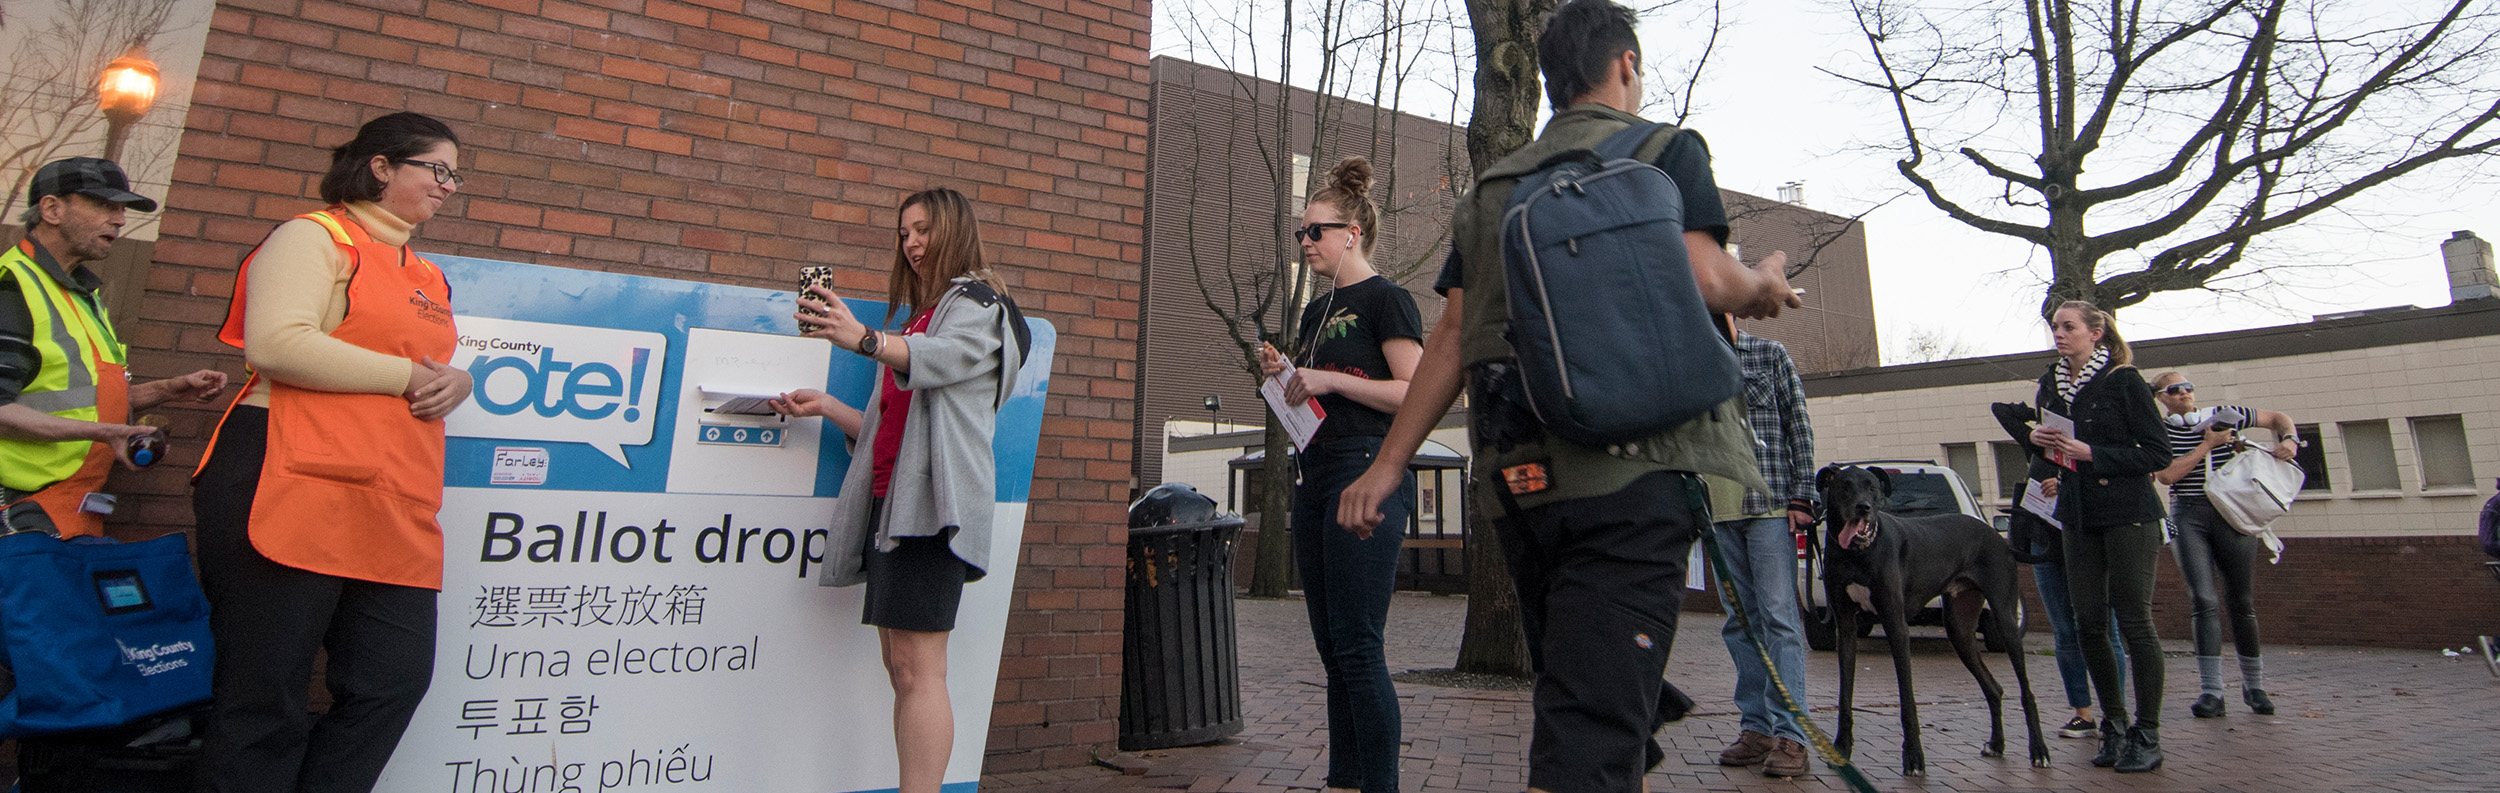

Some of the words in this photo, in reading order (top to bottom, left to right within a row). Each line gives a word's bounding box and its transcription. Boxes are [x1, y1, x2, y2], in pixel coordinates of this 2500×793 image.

[409, 297, 429, 311] King
[417, 309, 449, 328] Elections
[490, 337, 541, 354] County
[480, 510, 677, 564] Ballot
[694, 513, 830, 579] drop
[470, 583, 708, 629] 選票投放箱
[129, 647, 156, 661] King
[151, 640, 195, 656] County
[465, 643, 570, 680] Urna
[586, 635, 758, 676] electoral
[136, 658, 188, 677] Elections
[455, 694, 600, 740] 투표함
[445, 755, 586, 793] Thùng
[598, 743, 713, 793] phiếu
